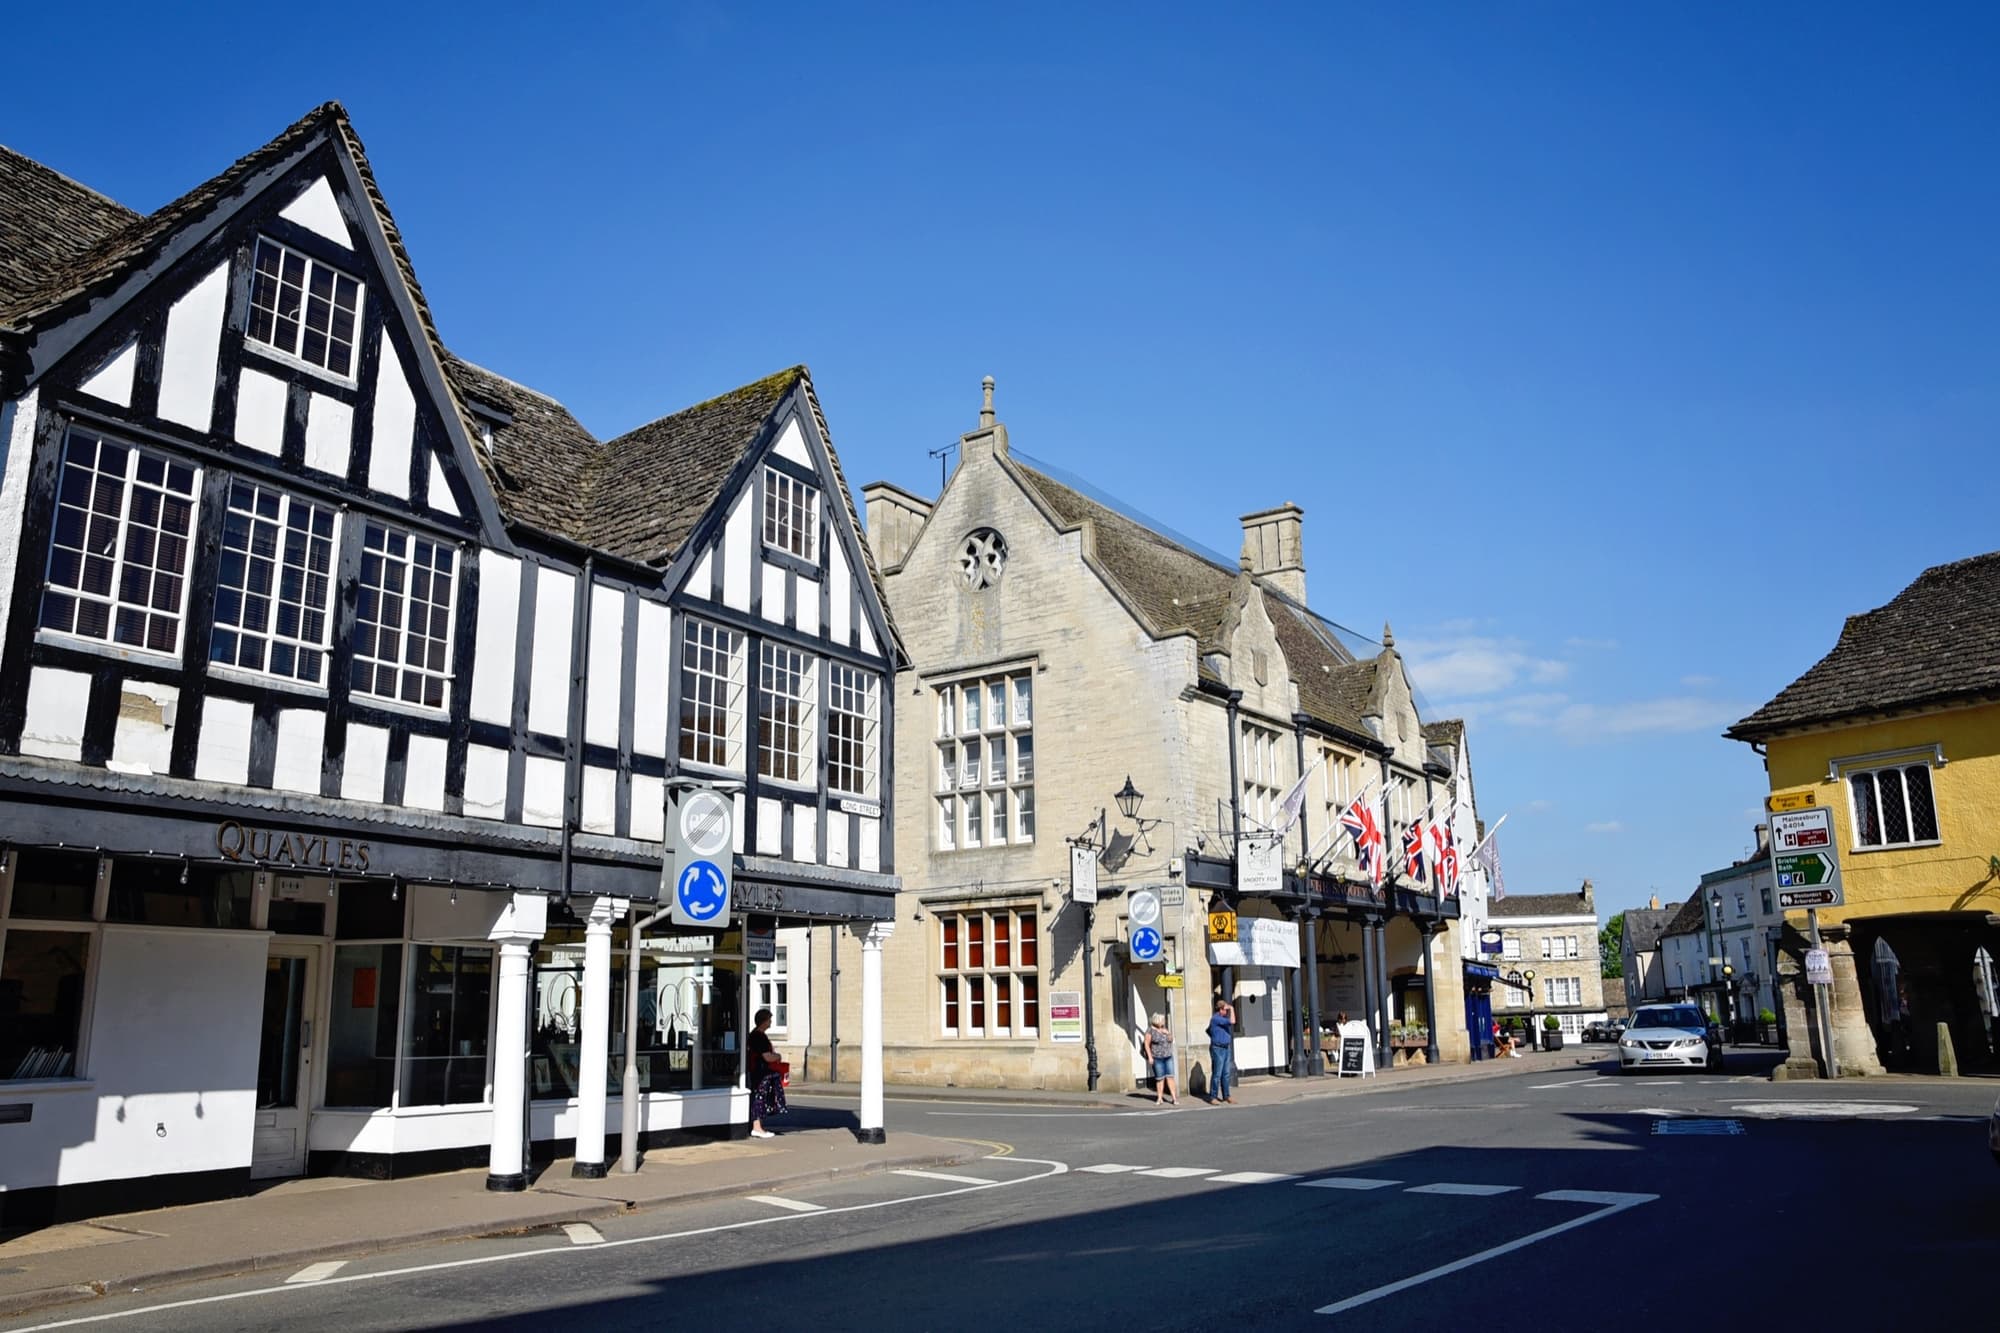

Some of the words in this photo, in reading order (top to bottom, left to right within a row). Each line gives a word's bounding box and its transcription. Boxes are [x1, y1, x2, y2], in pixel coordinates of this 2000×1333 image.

[842, 801, 857, 811] LONG
[859, 805, 879, 816] STREET
[1782, 814, 1820, 823] Malmesbury
[216, 820, 370, 872] QUAYLES
[1777, 856, 1798, 865] Bristol
[732, 883, 784, 908] AYLES
